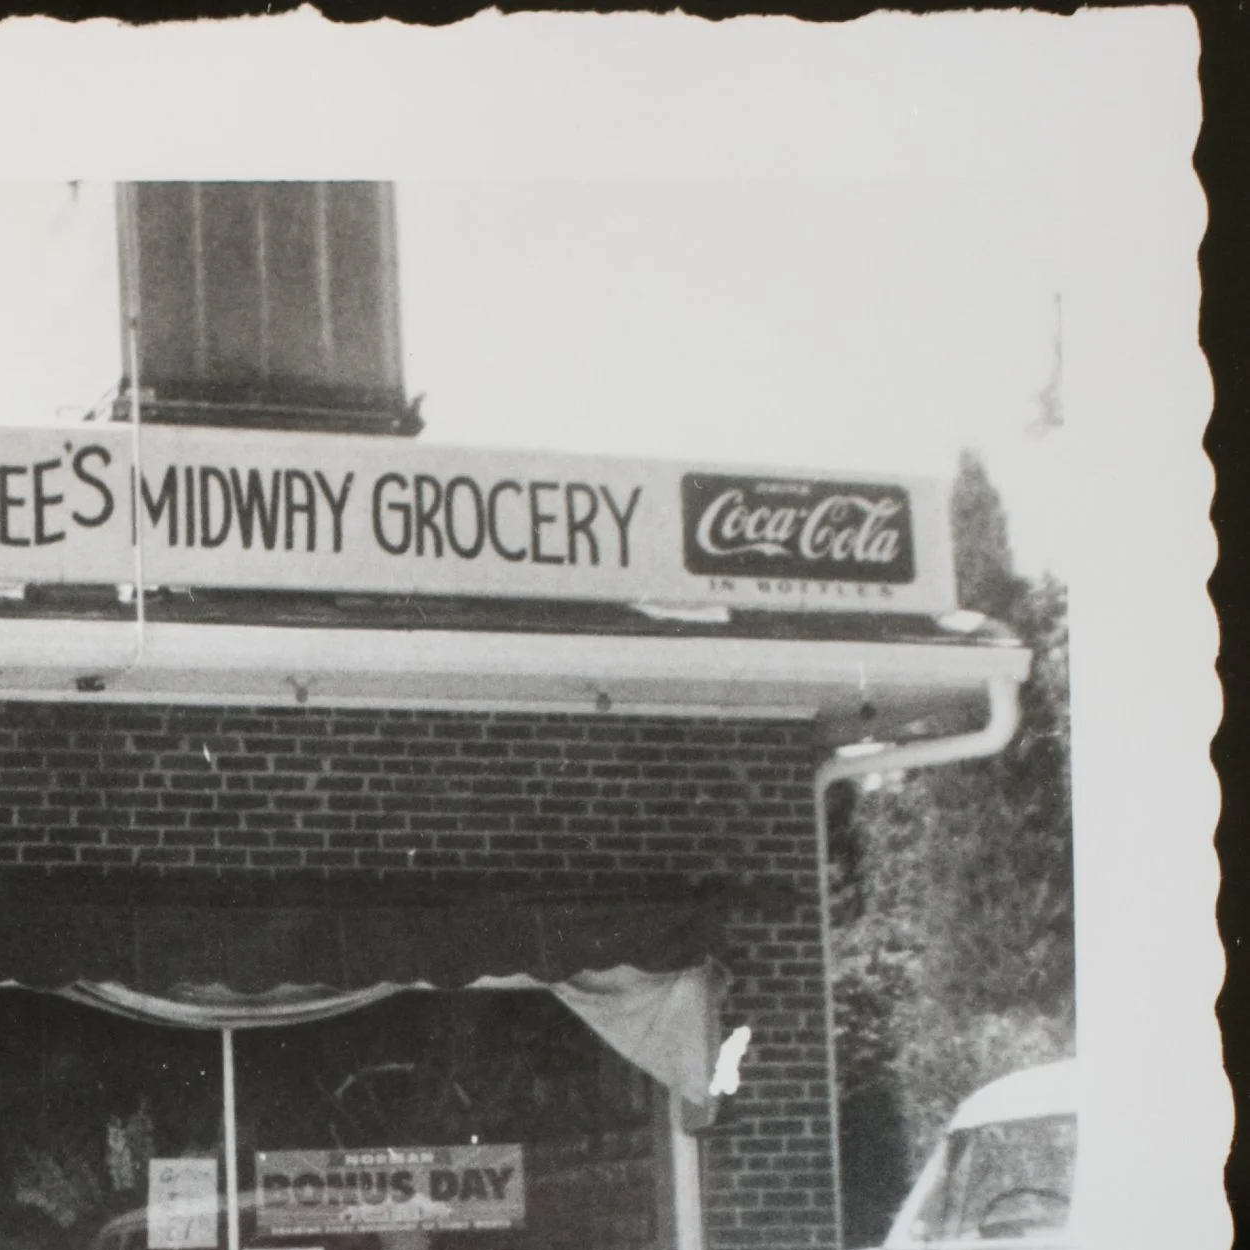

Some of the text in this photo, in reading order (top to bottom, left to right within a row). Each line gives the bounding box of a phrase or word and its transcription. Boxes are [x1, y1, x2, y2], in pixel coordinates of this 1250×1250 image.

[131, 465, 355, 553] MIDWAY
[372, 473, 643, 568] GROCERY
[696, 487, 903, 564] Coca-Cola
[430, 1166, 515, 1202] DAY
